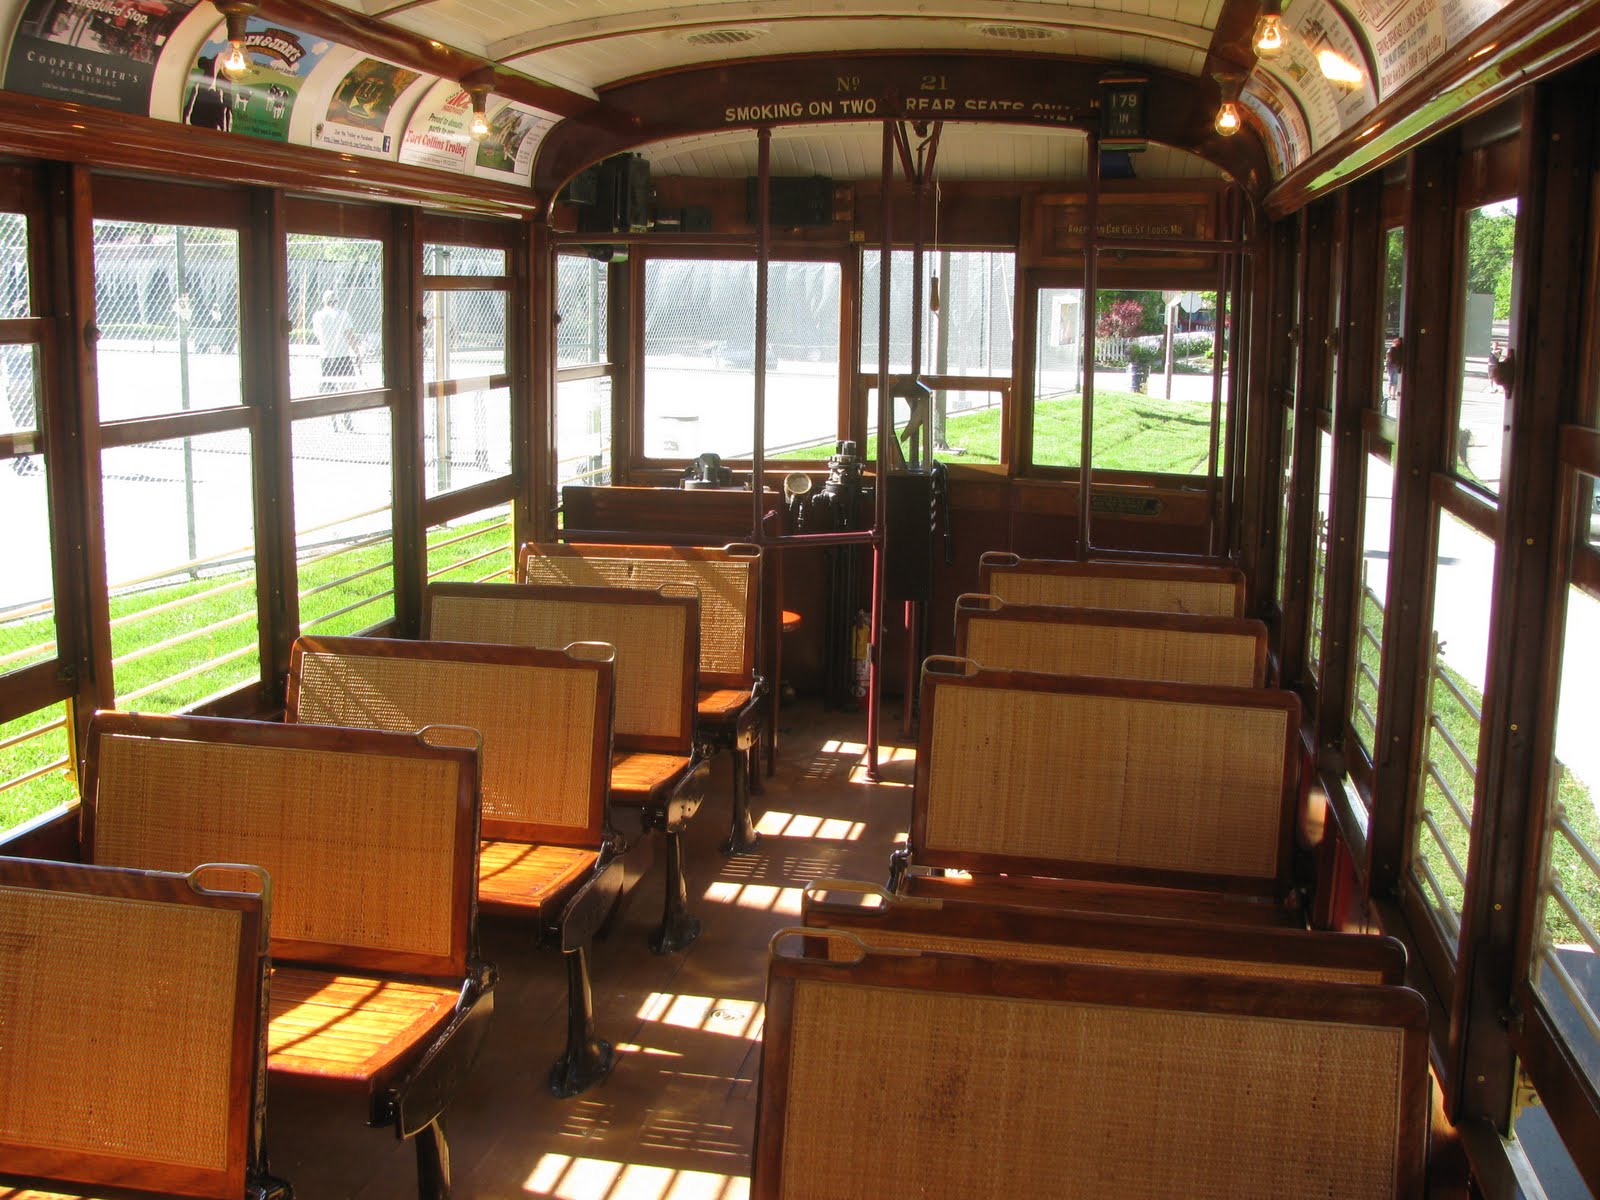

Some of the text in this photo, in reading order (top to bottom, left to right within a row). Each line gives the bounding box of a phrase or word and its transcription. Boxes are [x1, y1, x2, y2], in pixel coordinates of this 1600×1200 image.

[124, 7, 148, 26] Stop.
[920, 75, 947, 90] 21
[1112, 93, 1137, 108] 179
[725, 103, 802, 122] SMOKING
[808, 101, 832, 116] ON
[840, 99, 876, 114] TWO
[428, 112, 442, 125] Proud
[442, 116, 448, 125] to
[428, 124, 441, 134] parts
[406, 130, 467, 157] Fort Collins Trolley
